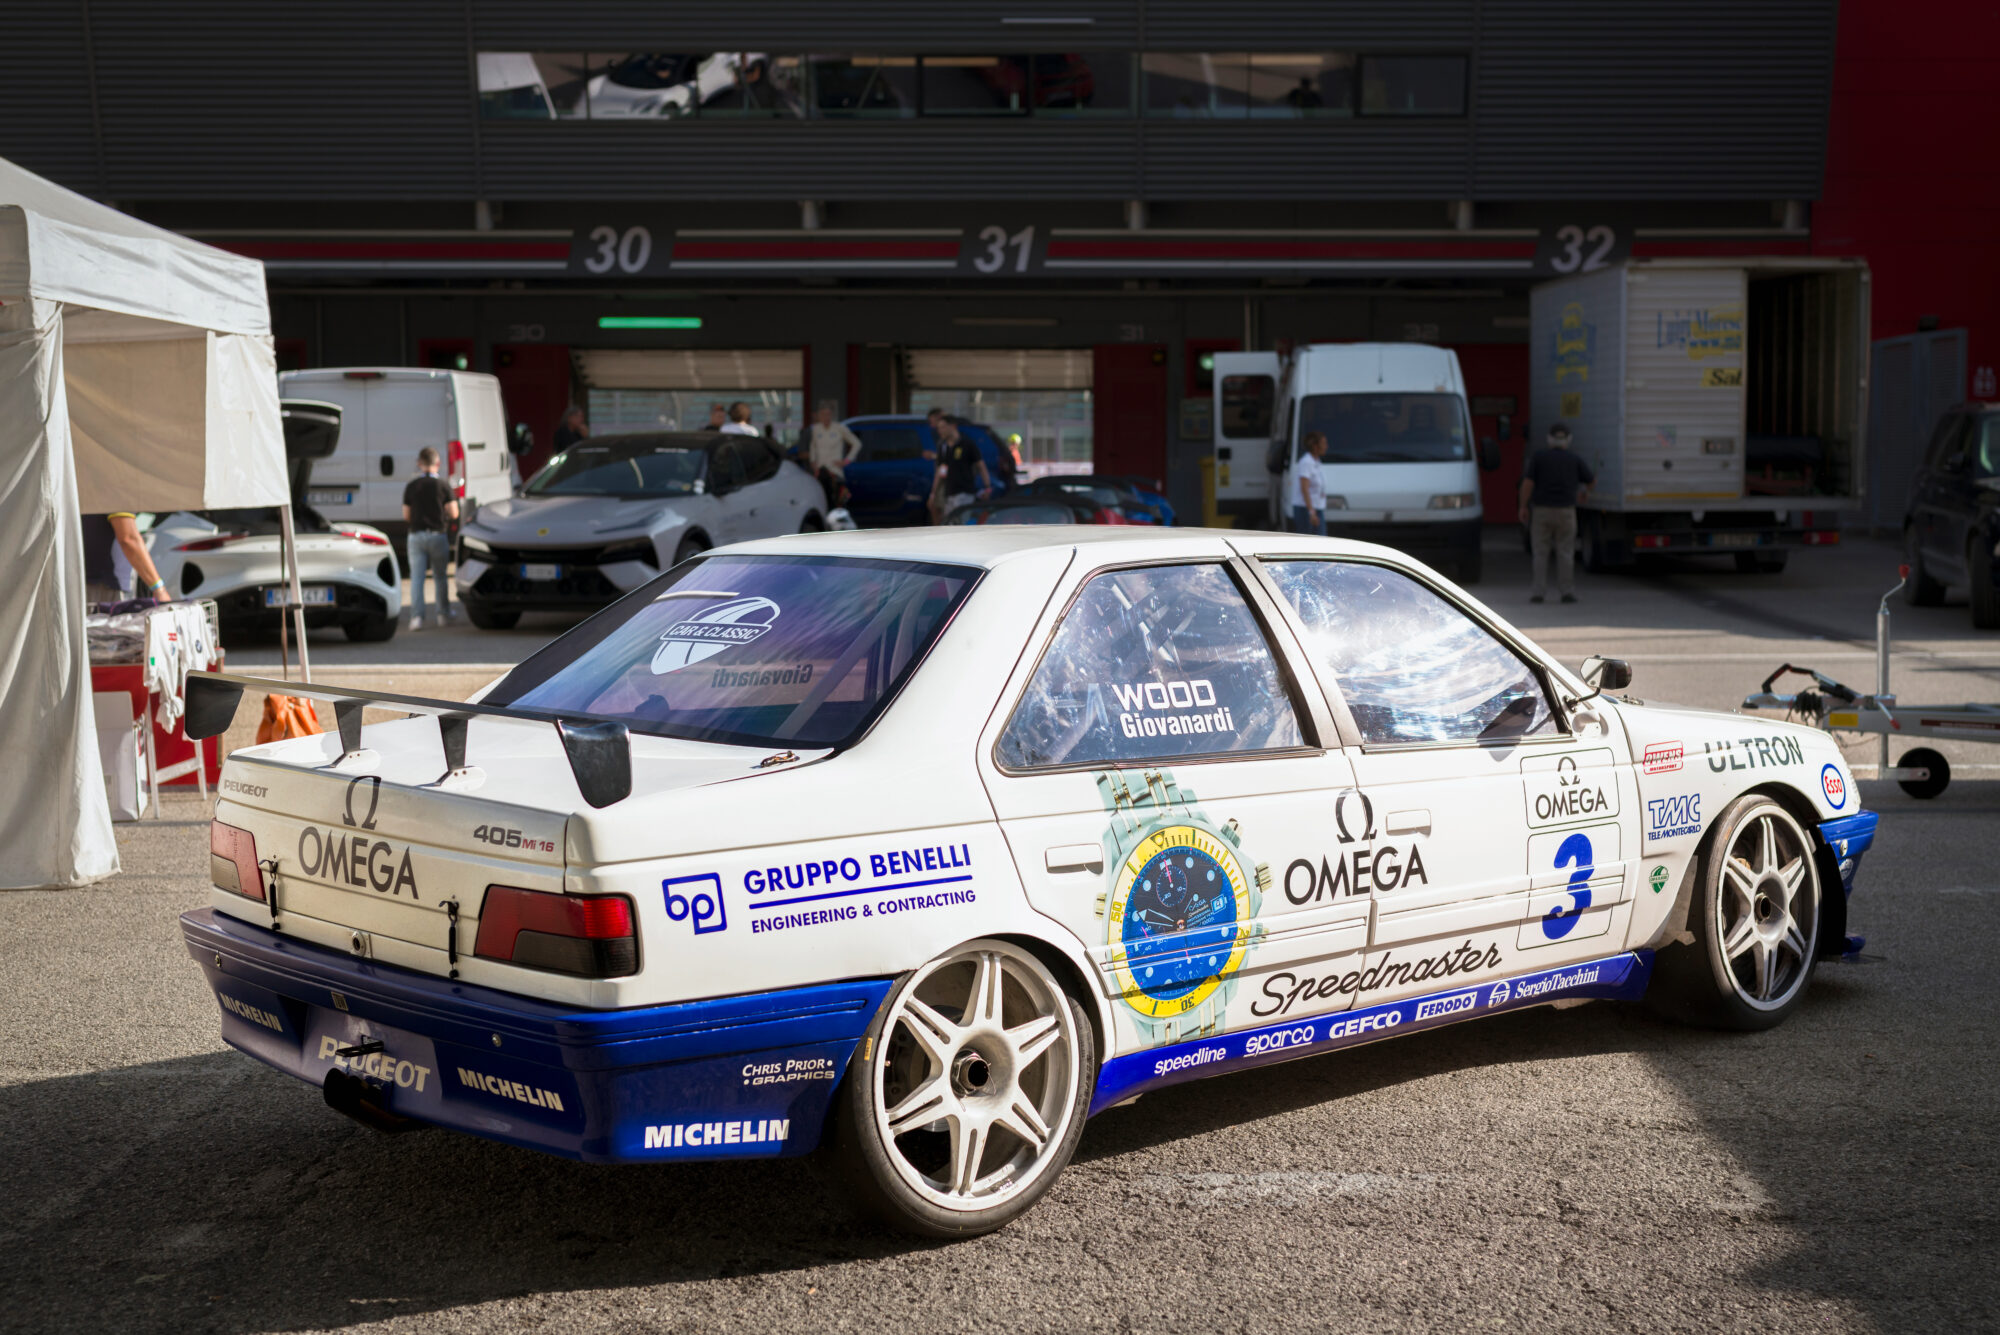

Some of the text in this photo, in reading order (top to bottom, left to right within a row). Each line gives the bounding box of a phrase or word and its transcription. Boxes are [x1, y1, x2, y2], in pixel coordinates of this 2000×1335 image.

[584, 225, 653, 274] 30
[973, 225, 1036, 273] 31
[1551, 224, 1616, 273] 32
[509, 324, 545, 342] 30
[669, 625, 760, 639] CAR & CLASSIC
[1111, 679, 1217, 711] WOOD
[1120, 706, 1235, 738] Giovanardi
[1704, 735, 1804, 773] ULTRON
[223, 779, 269, 798] PEUGEOT
[1824, 775, 1843, 794] Esso
[1535, 786, 1609, 820] OMEGA
[1648, 793, 1701, 830] TMC
[473, 824, 522, 848] 405
[299, 826, 420, 900] OMEGA
[744, 843, 972, 895] GRUPPO BENELLI
[1284, 843, 1429, 906] OMEGA
[1542, 833, 1595, 940] 3
[751, 889, 977, 934] ENGINEERING & CONTRACTING
[1250, 939, 1503, 1017] Speedmaster
[219, 992, 284, 1033] MICHELIN
[1419, 996, 1473, 1017] FERODO
[1245, 1025, 1315, 1057] sparco
[1328, 1010, 1402, 1039] GEFCO
[742, 1062, 782, 1077] CHRIS
[752, 1070, 835, 1086] GRAPHICS
[1153, 1047, 1227, 1077] speedline
[457, 1067, 565, 1112] MICHELIN
[644, 1119, 790, 1149] MICHELIN
